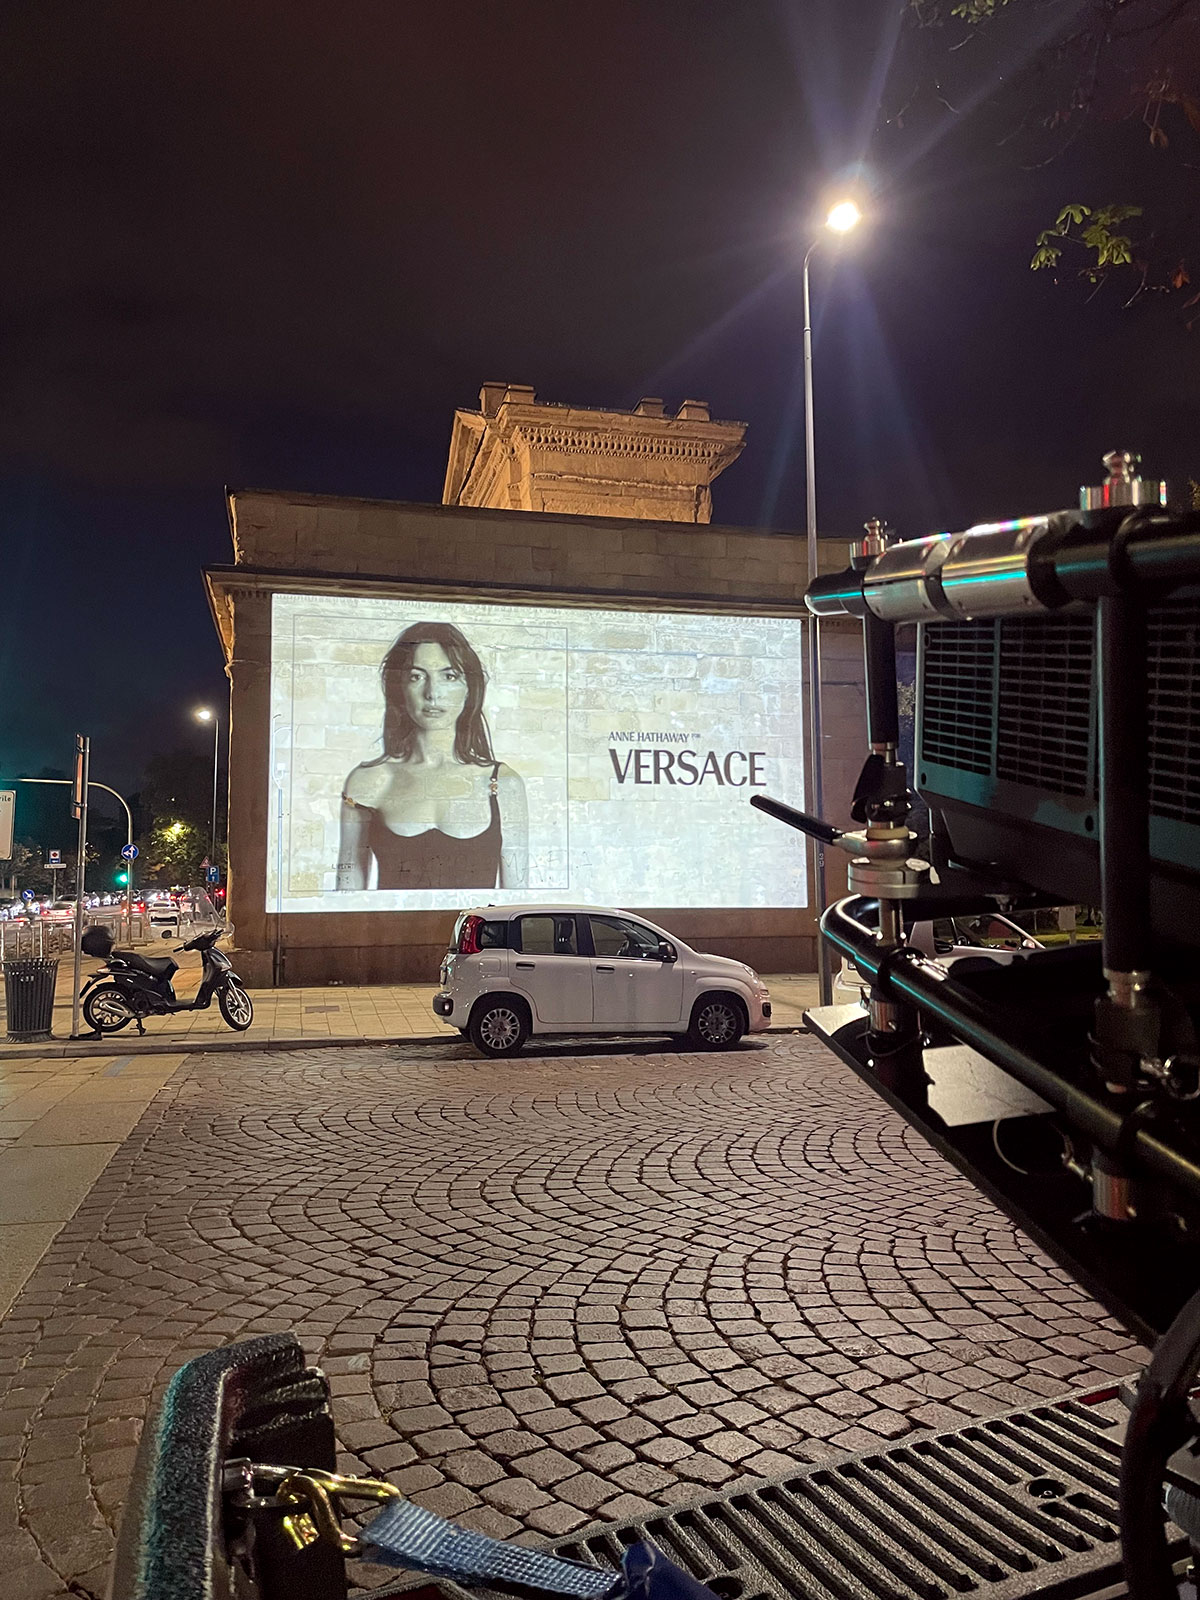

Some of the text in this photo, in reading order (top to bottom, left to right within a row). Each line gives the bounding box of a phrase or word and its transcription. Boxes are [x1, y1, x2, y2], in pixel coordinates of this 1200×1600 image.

[608, 731, 635, 742] ANNE
[637, 732, 689, 743] HATHAWAY
[608, 748, 767, 787] VERSACE
[210, 867, 216, 875] P
